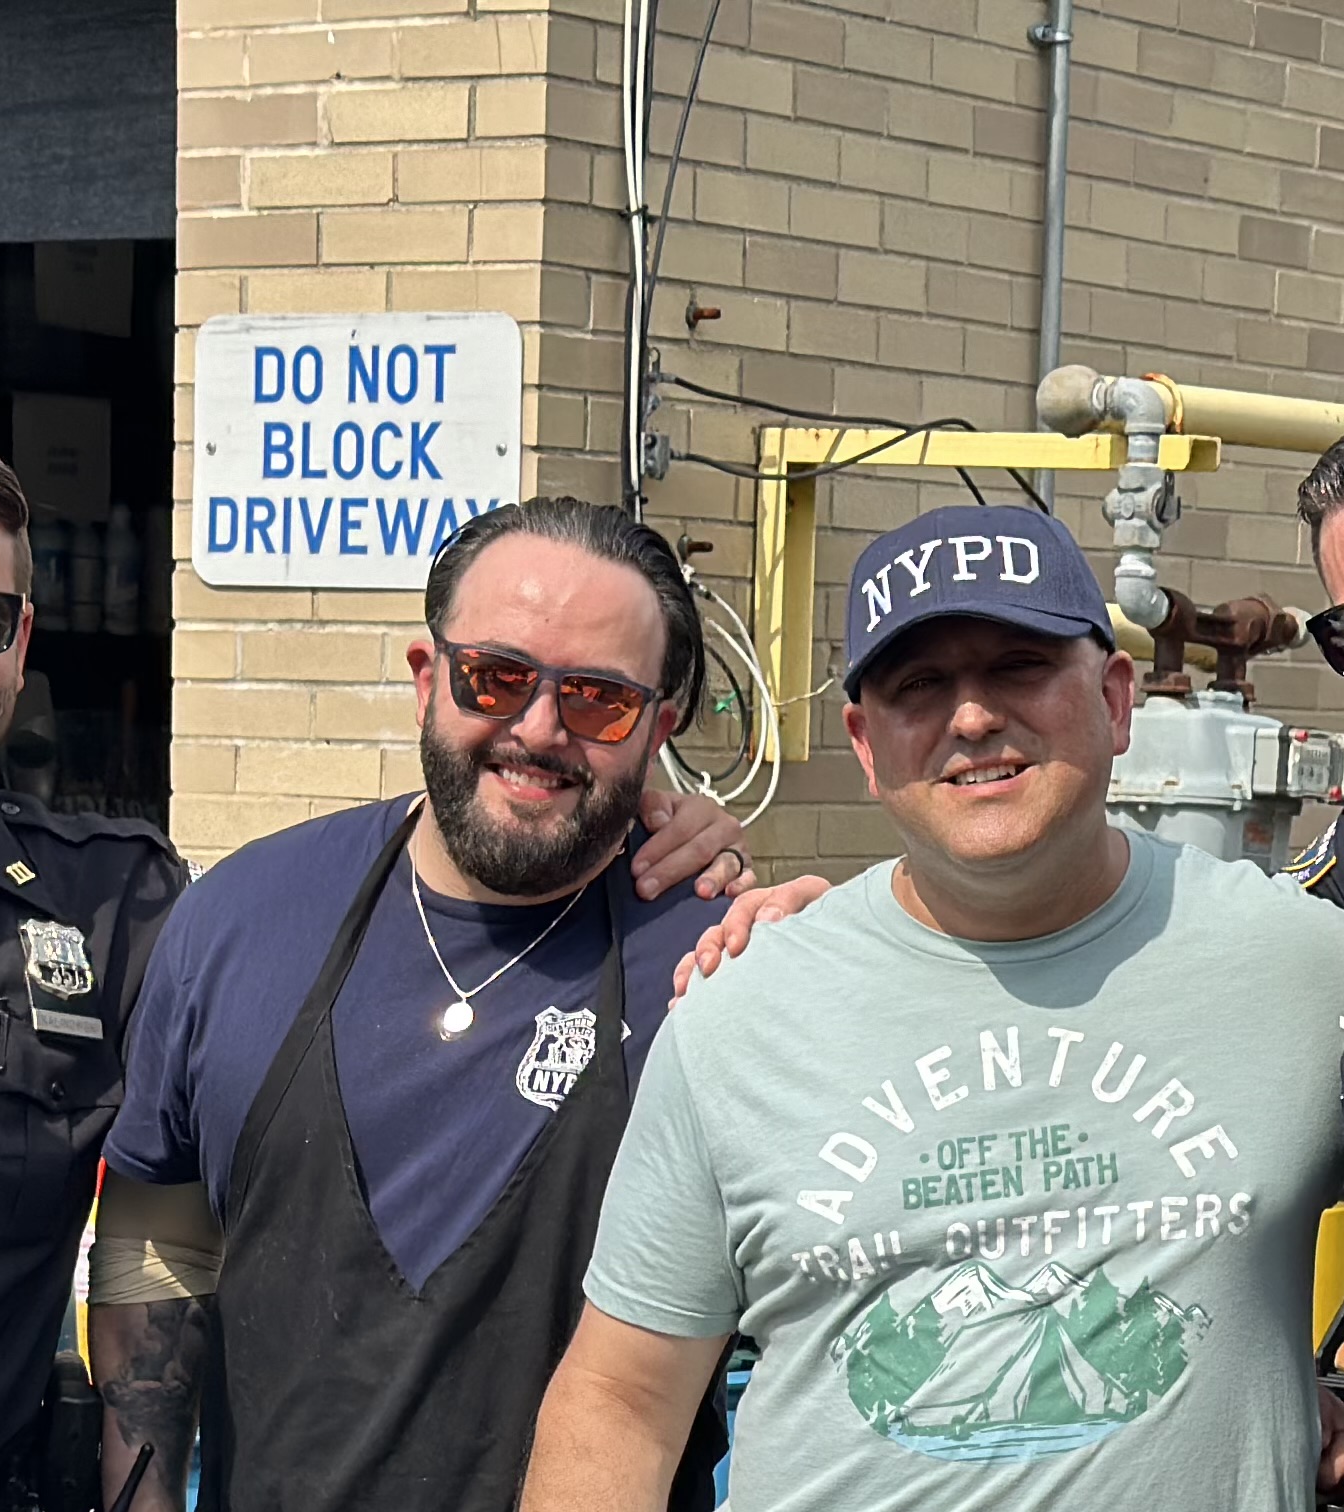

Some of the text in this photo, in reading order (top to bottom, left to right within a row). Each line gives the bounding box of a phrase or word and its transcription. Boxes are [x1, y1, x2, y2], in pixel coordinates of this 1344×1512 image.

[253, 343, 457, 405] DO NOT
[262, 420, 444, 481] BLOCK
[861, 534, 1039, 633] NYPD
[532, 1070, 578, 1095] NYP
[795, 1025, 1240, 1225] ADVENTURE
[936, 1122, 1073, 1170] OFF THE
[901, 1152, 1120, 1211] BEATEN PATH
[791, 1192, 1252, 1282] TRAIL OUTFITTERS
